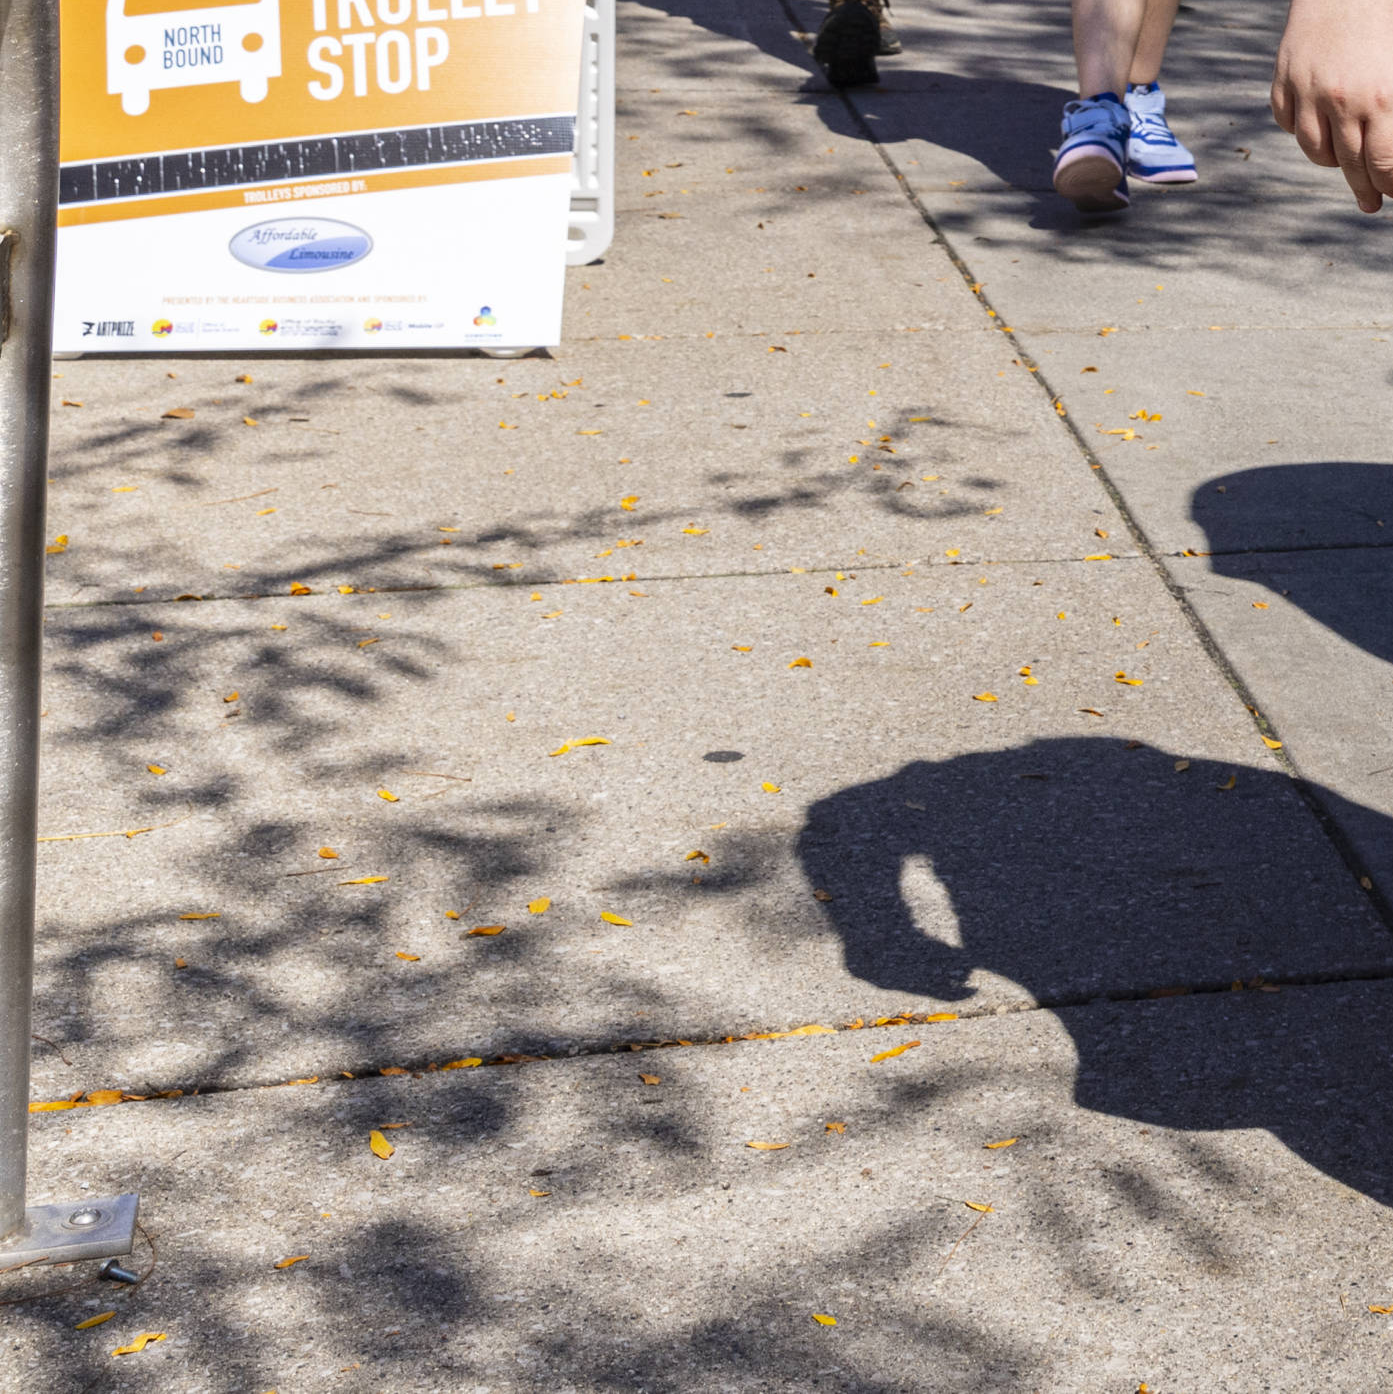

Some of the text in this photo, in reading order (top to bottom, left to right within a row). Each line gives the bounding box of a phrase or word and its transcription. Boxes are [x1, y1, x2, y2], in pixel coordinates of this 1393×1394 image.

[163, 24, 222, 48] NORTH
[163, 45, 224, 70] BOUND
[307, 26, 450, 101] STOP
[243, 187, 292, 204] TROLLEYS
[293, 181, 351, 199] SPONSORED
[248, 227, 318, 245] Affordable
[288, 247, 355, 260] Limousine
[96, 320, 135, 337] ARTPRIZE
